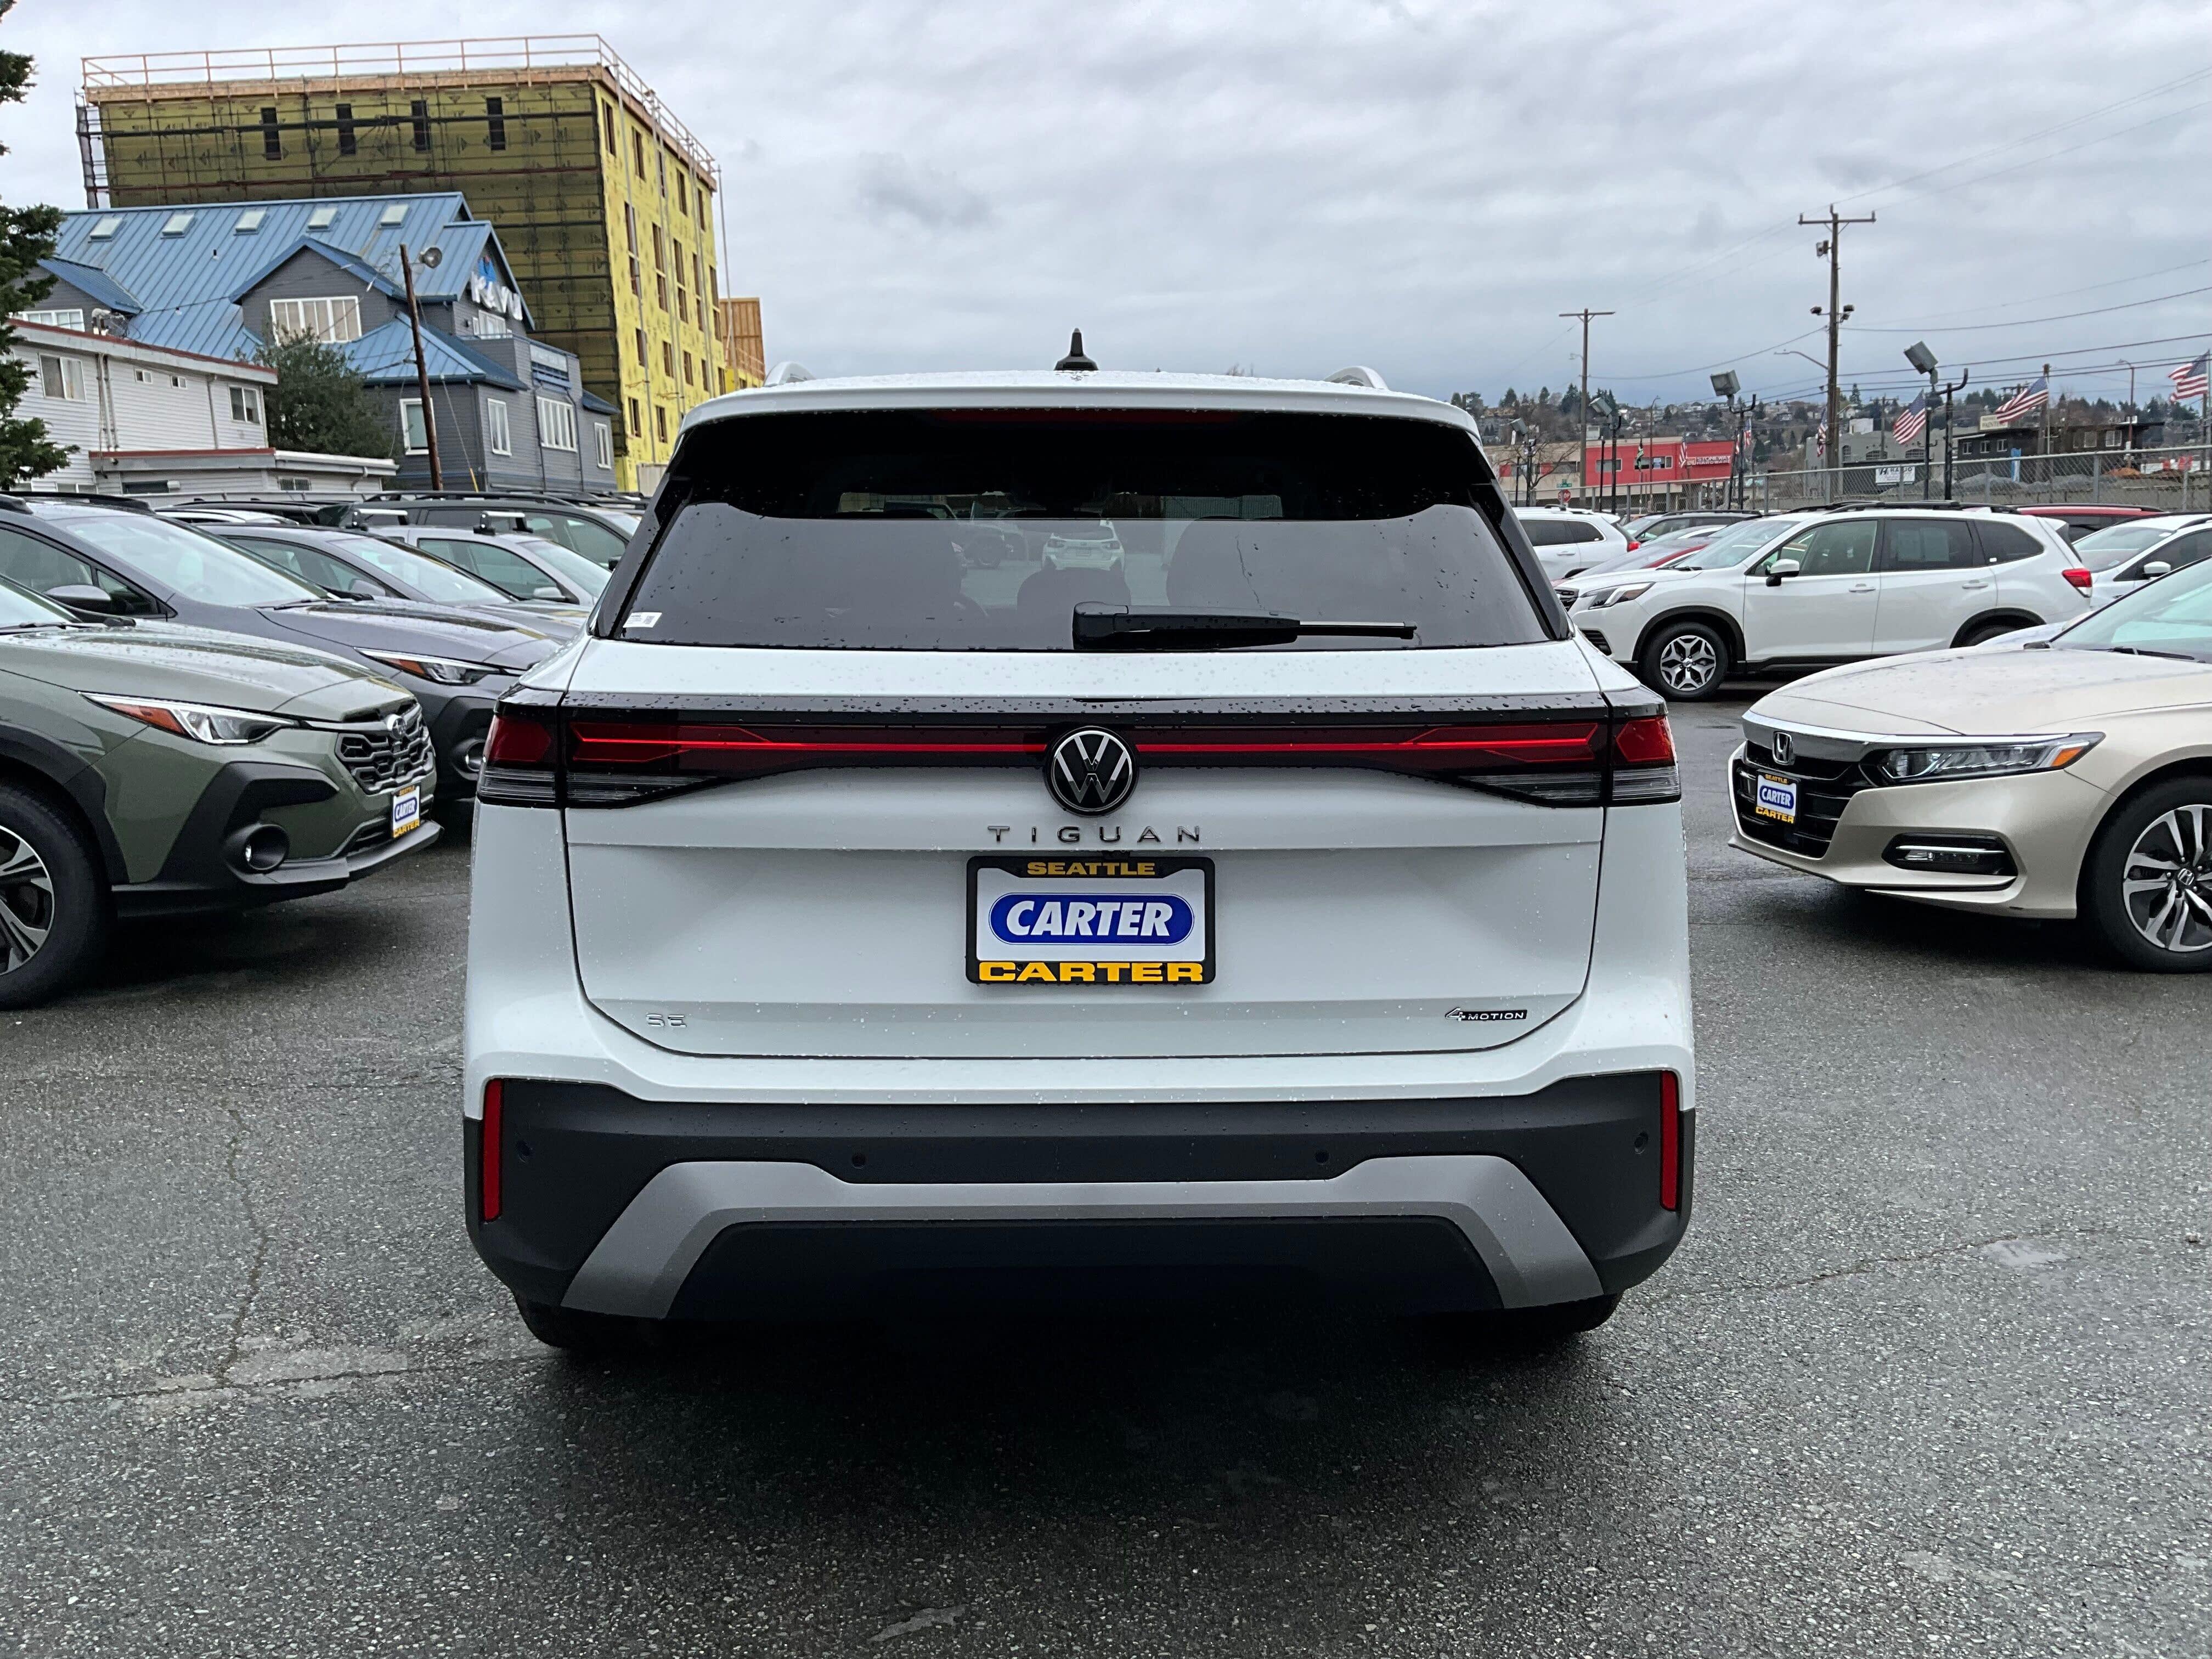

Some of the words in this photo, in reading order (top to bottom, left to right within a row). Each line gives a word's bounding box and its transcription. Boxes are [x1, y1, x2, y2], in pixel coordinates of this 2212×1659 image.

[470, 271, 523, 320] KAVU
[1765, 774, 1788, 784] SEATTLE
[1761, 788, 1791, 806] CARTER
[396, 799, 416, 820] CARTER
[1756, 806, 1795, 824] CARTER
[393, 820, 420, 838] CARTER
[988, 826, 1200, 843] TIGUAN
[1027, 862, 1155, 876] SEATTLE
[1006, 900, 1173, 936] CARTER
[979, 962, 1203, 982] CARTER
[646, 1013, 686, 1028] SE
[1445, 1007, 1525, 1022] 4MOTION
